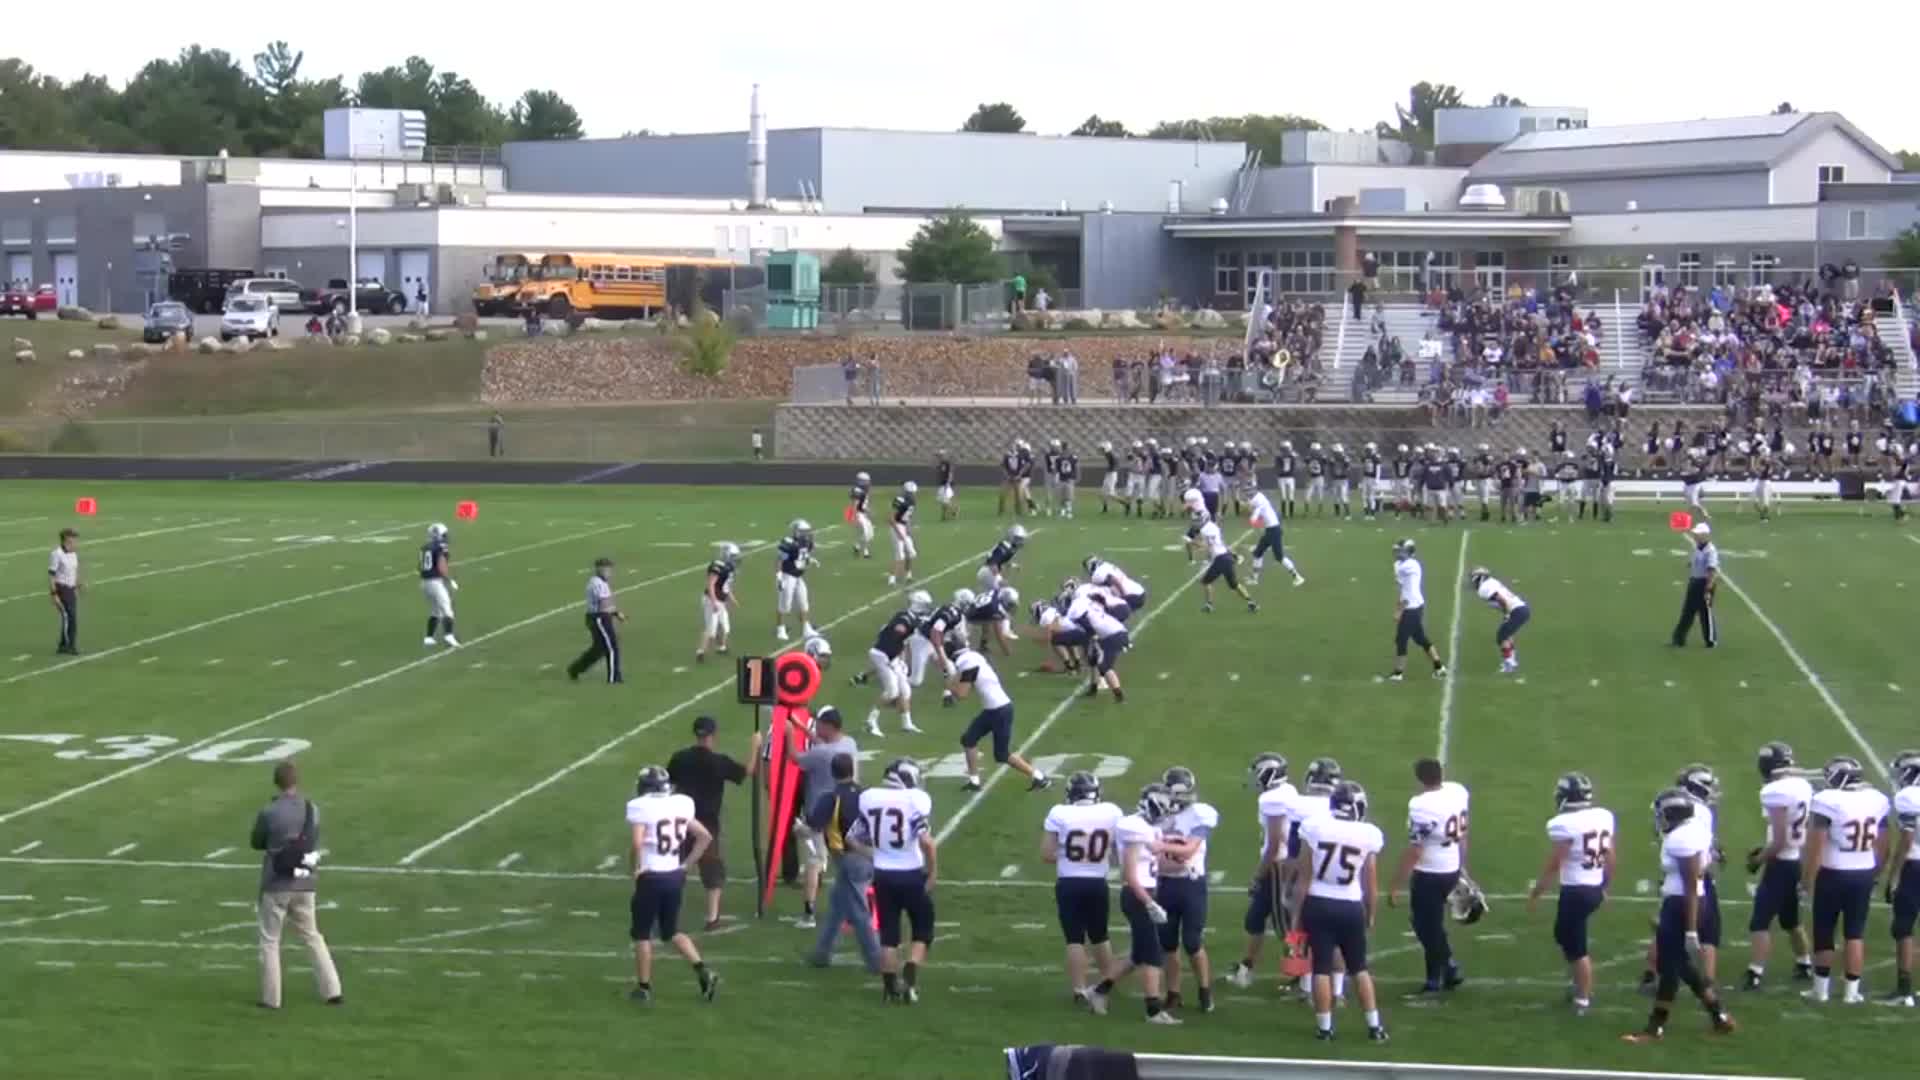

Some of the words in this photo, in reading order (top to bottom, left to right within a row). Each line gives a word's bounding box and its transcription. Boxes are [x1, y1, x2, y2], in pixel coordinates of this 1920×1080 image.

[53, 733, 313, 763] 30
[656, 816, 688, 856] 65
[867, 808, 906, 849] 73
[1064, 829, 1110, 863] 60
[1839, 816, 1877, 852] 36
[1315, 840, 1361, 886] 75
[1581, 828, 1611, 870] 56
